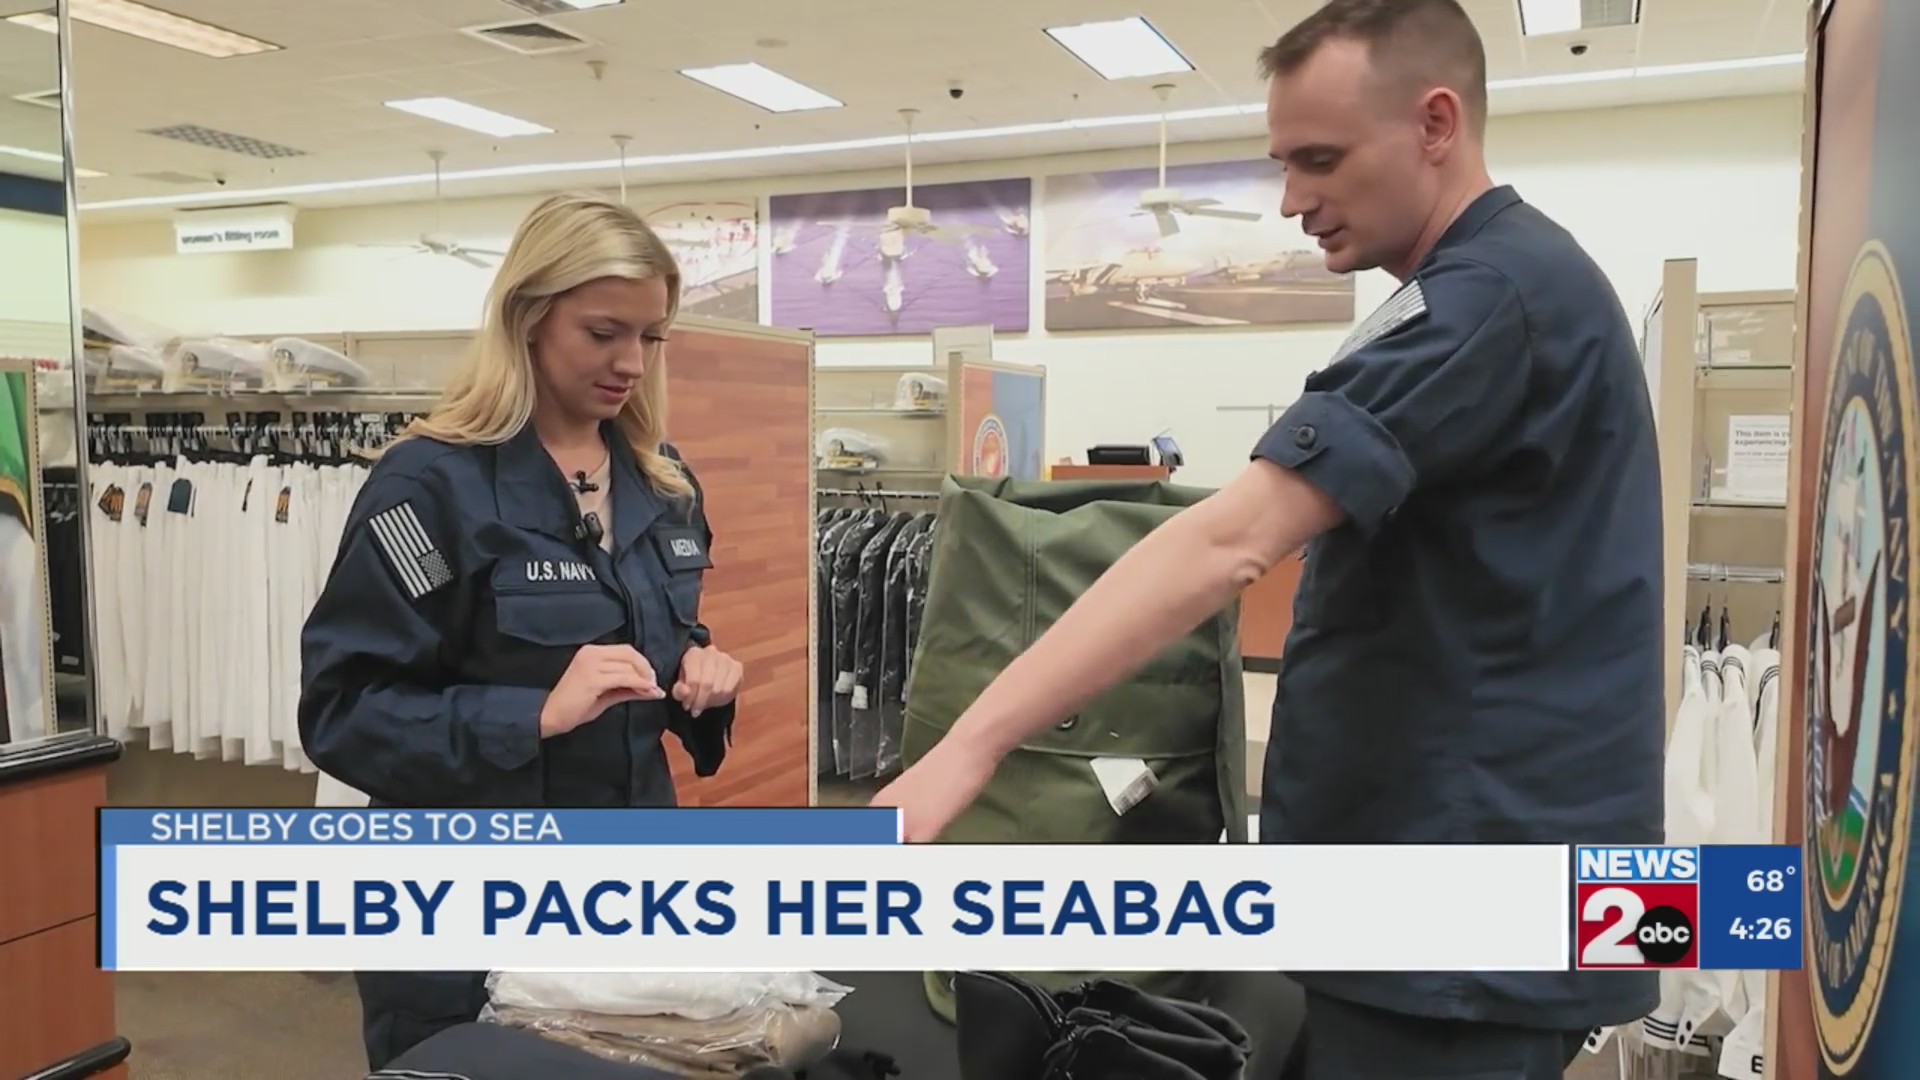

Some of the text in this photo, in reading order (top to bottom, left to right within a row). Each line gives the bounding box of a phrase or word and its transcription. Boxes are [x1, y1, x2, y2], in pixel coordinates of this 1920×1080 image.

[181, 230, 280, 244] women's fitting room
[1735, 430, 1752, 438] This
[669, 538, 701, 557] MEDIA
[526, 561, 597, 581] U.S. NAVY
